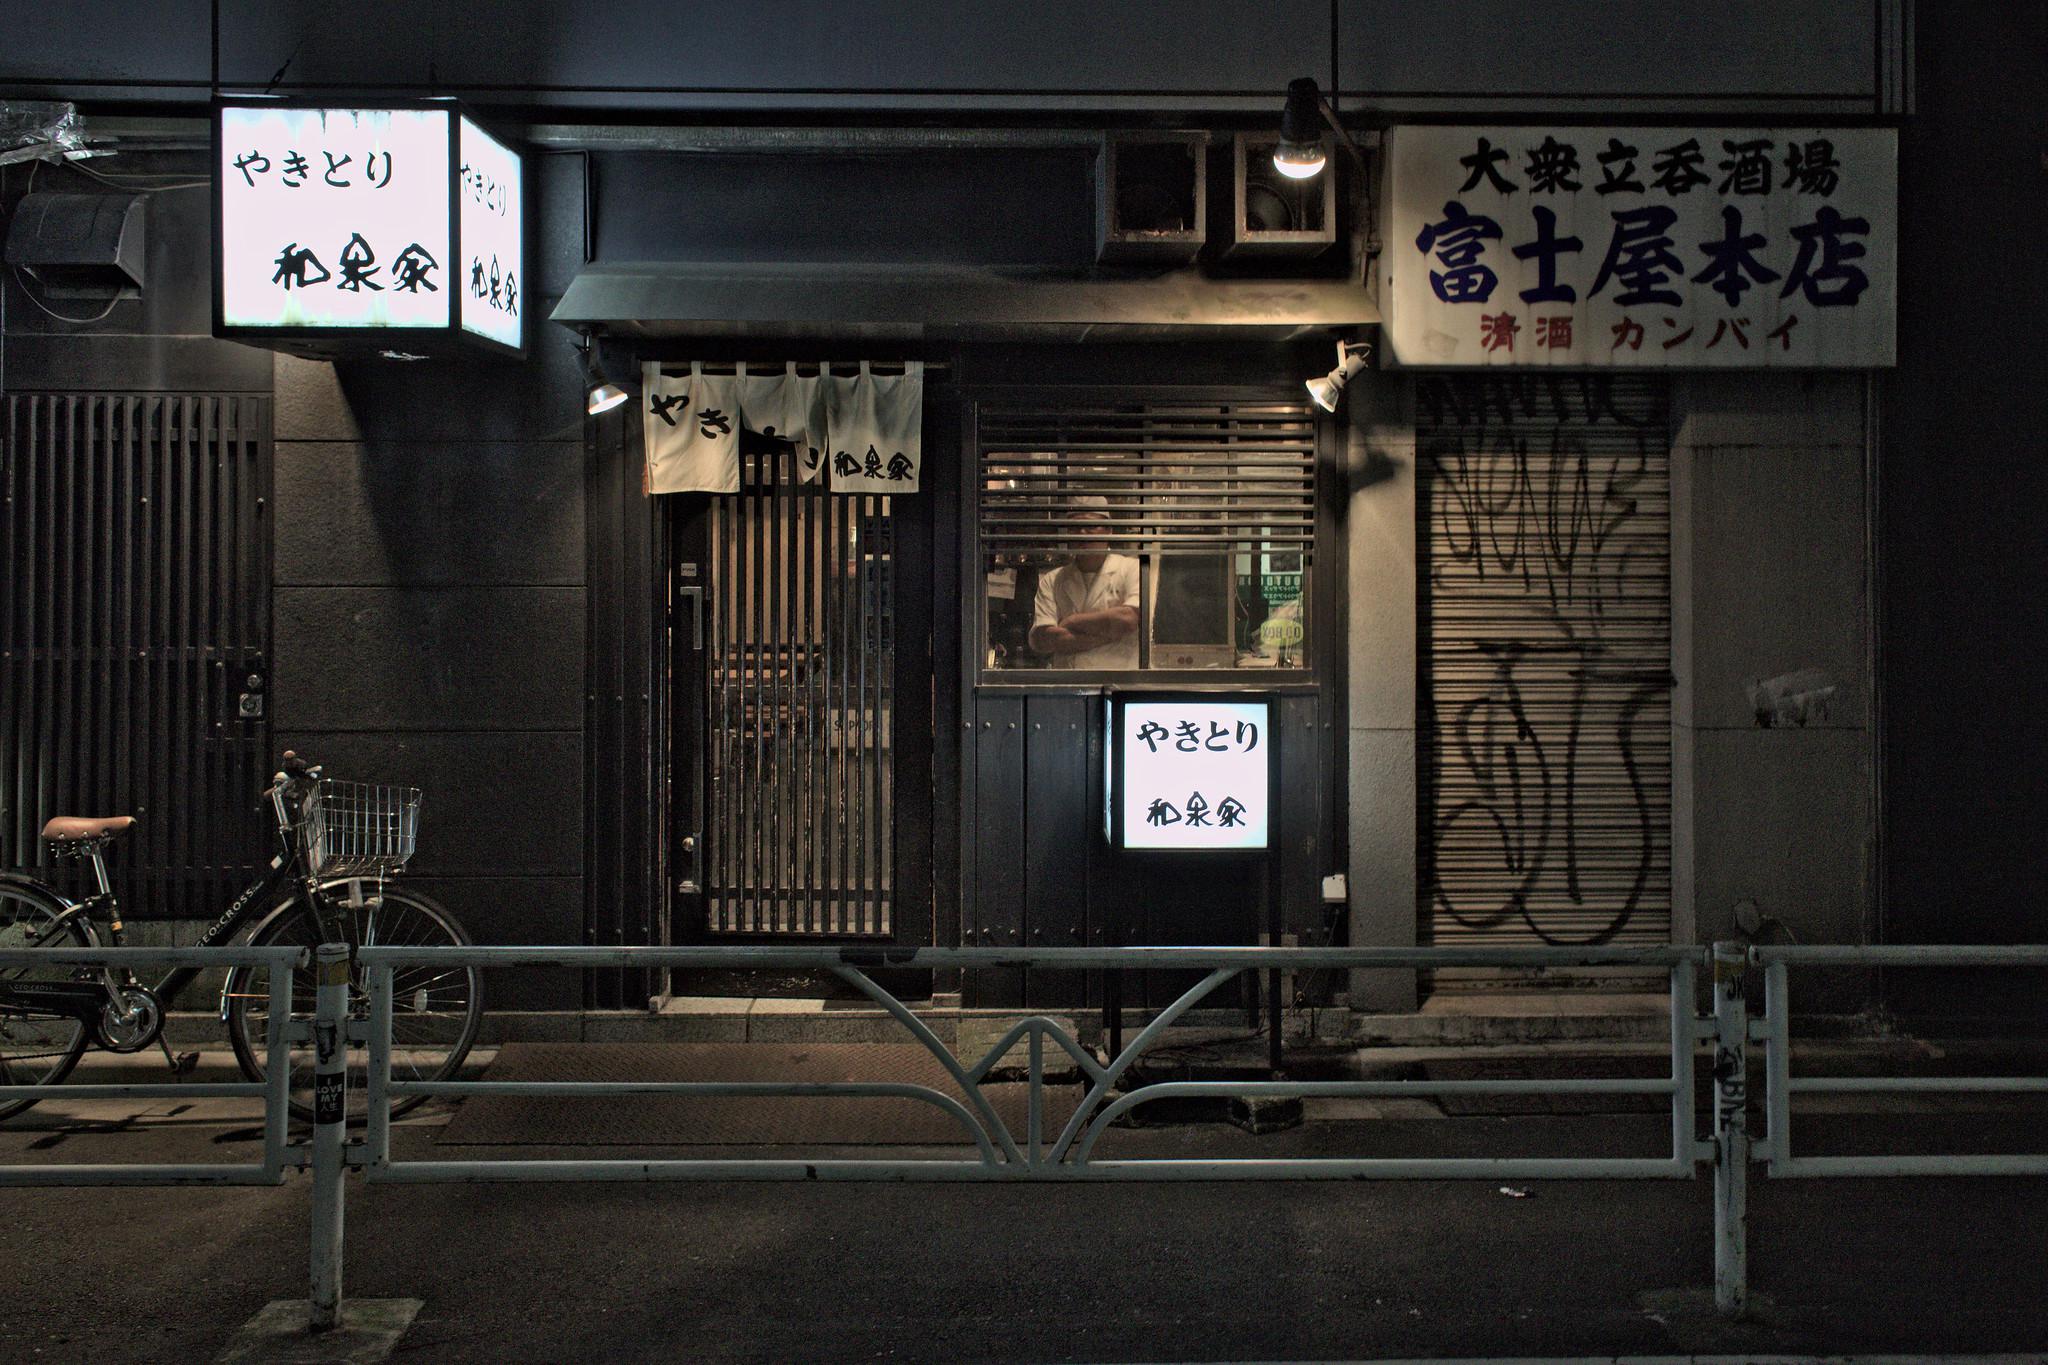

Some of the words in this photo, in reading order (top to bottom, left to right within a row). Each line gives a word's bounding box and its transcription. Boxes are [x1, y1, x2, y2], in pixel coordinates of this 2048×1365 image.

[232, 150, 393, 189] やきとり
[1459, 136, 1841, 198] 大衆立呑酒場
[460, 162, 507, 217] やきとり
[1415, 201, 1872, 308] 富士屋本店
[1611, 315, 1800, 352] カンバイ
[1136, 720, 1258, 753] やきとり
[317, 1084, 343, 1094] LOVE
[321, 1093, 338, 1103] MY
